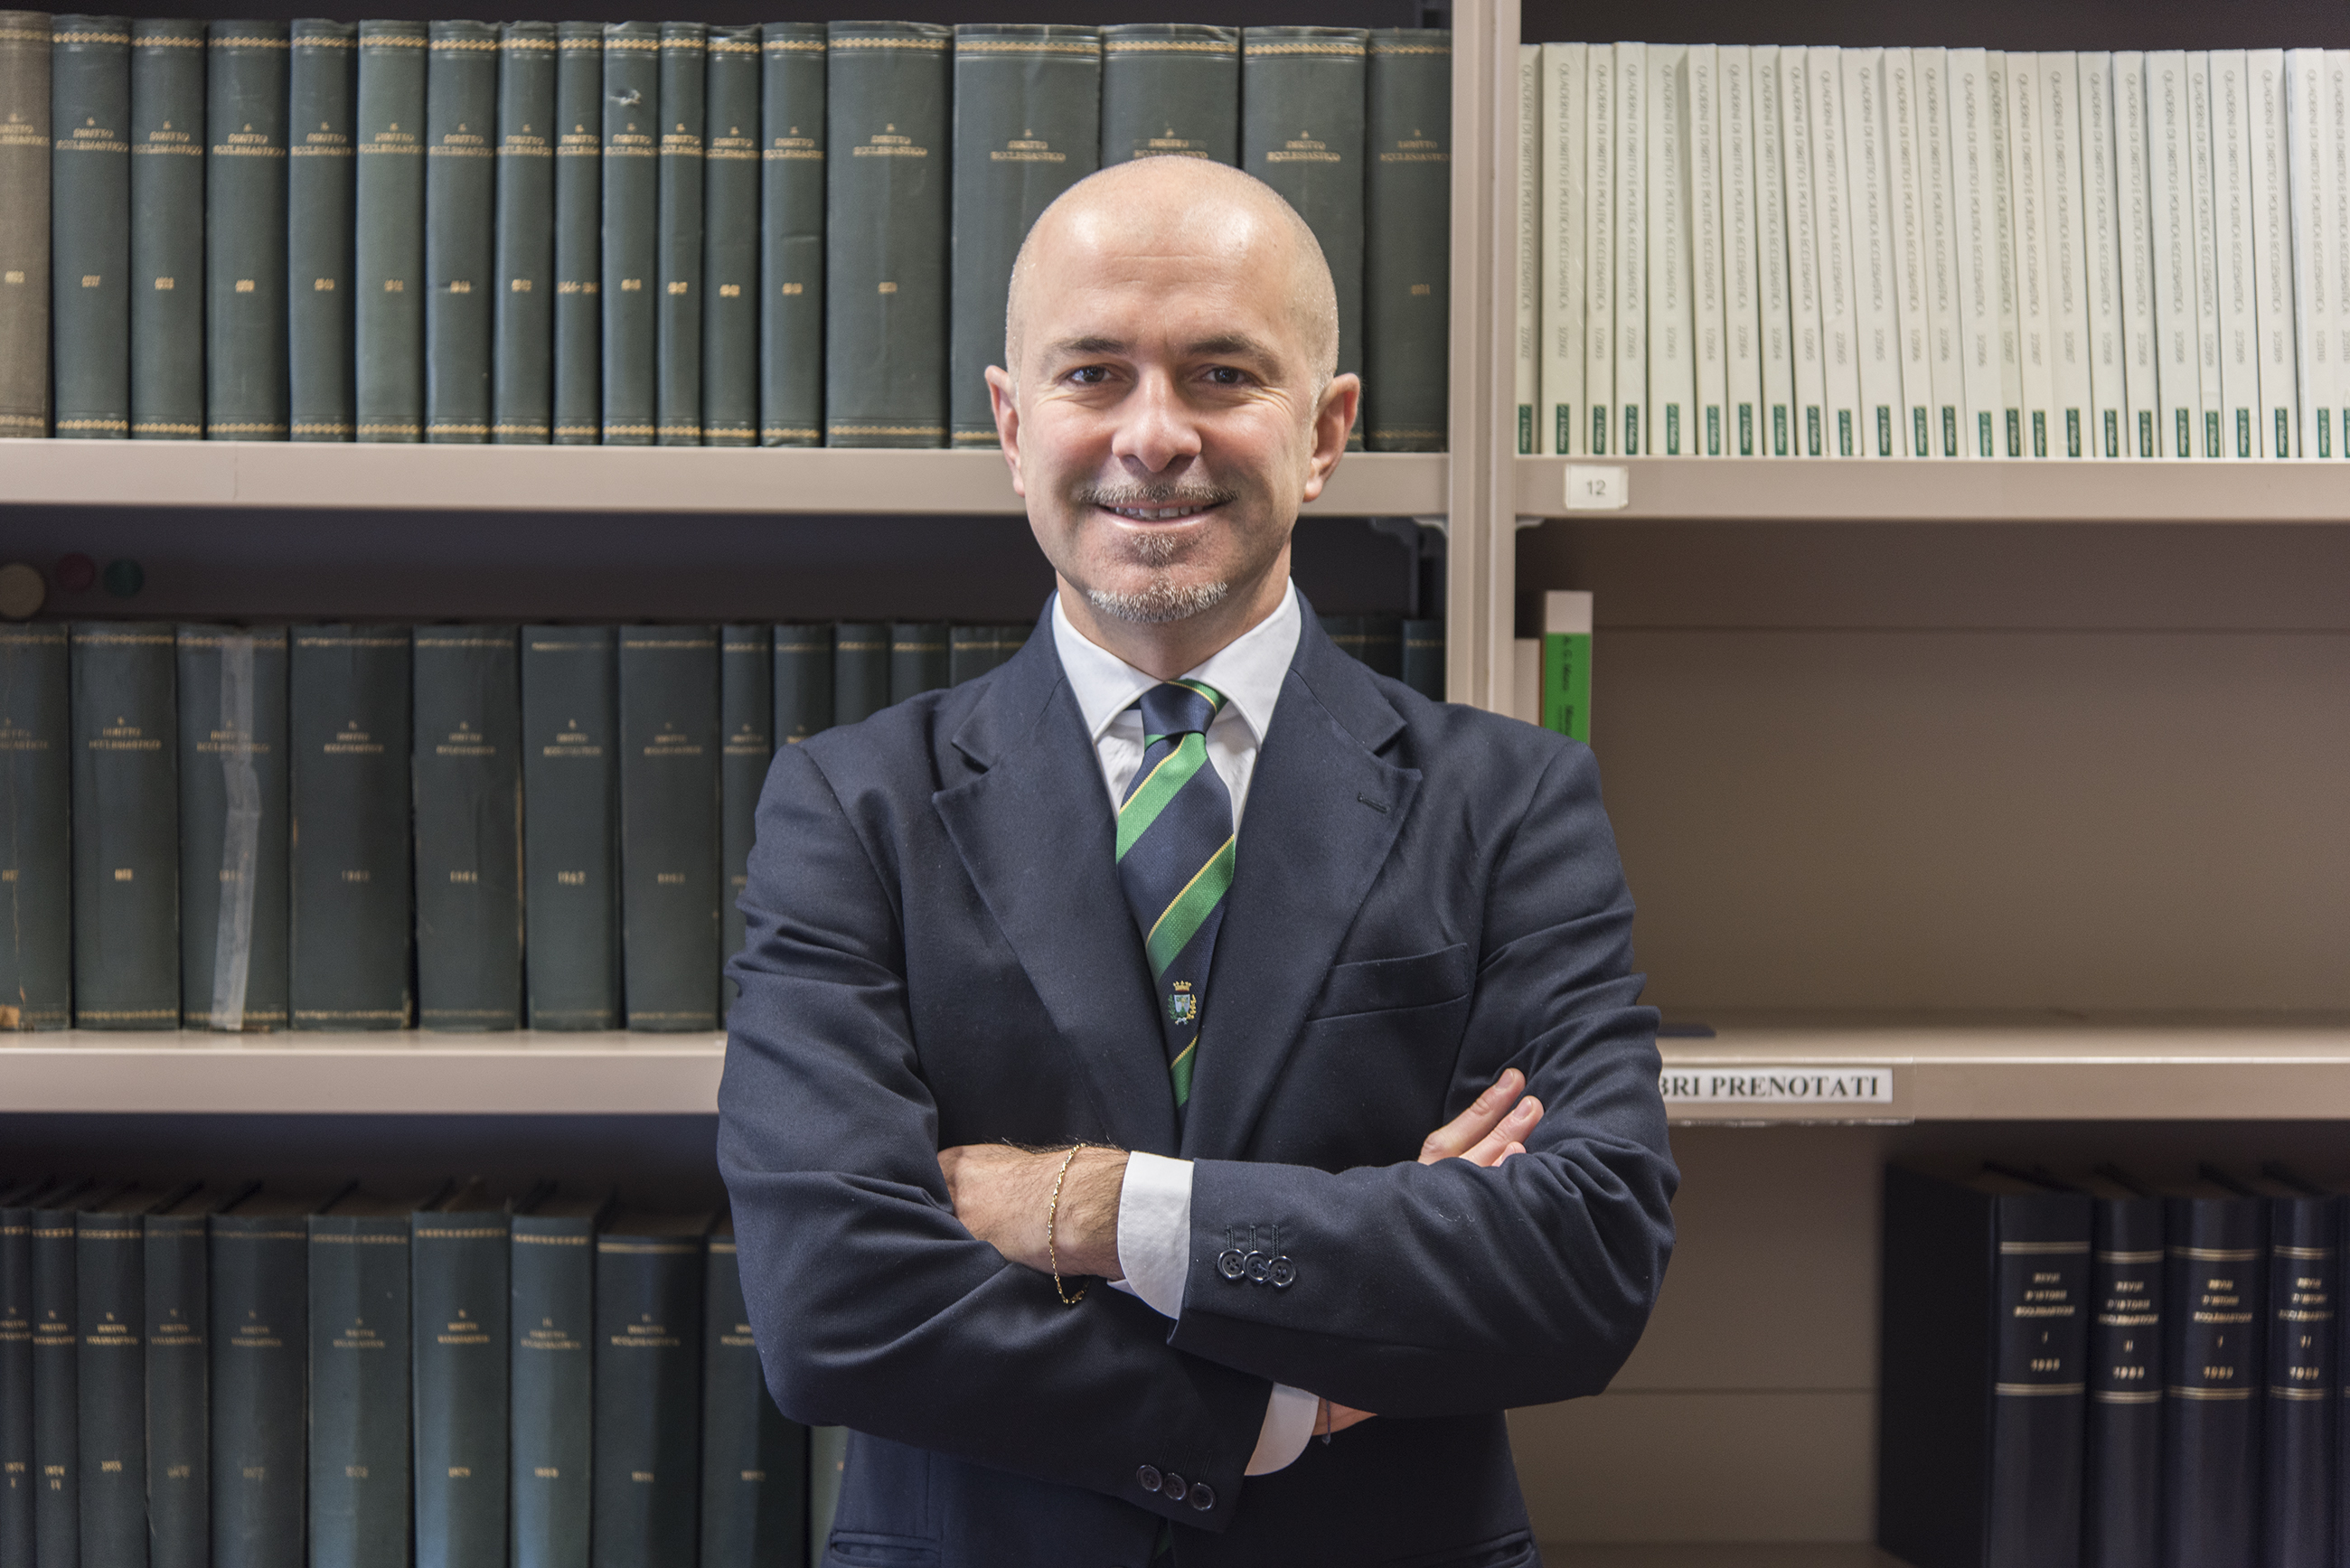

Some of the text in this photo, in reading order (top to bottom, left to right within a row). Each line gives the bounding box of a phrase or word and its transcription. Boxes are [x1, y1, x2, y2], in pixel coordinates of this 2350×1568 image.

[1586, 480, 1606, 495] 12
[1659, 1075, 1880, 1097] BRI PRENOTATI
